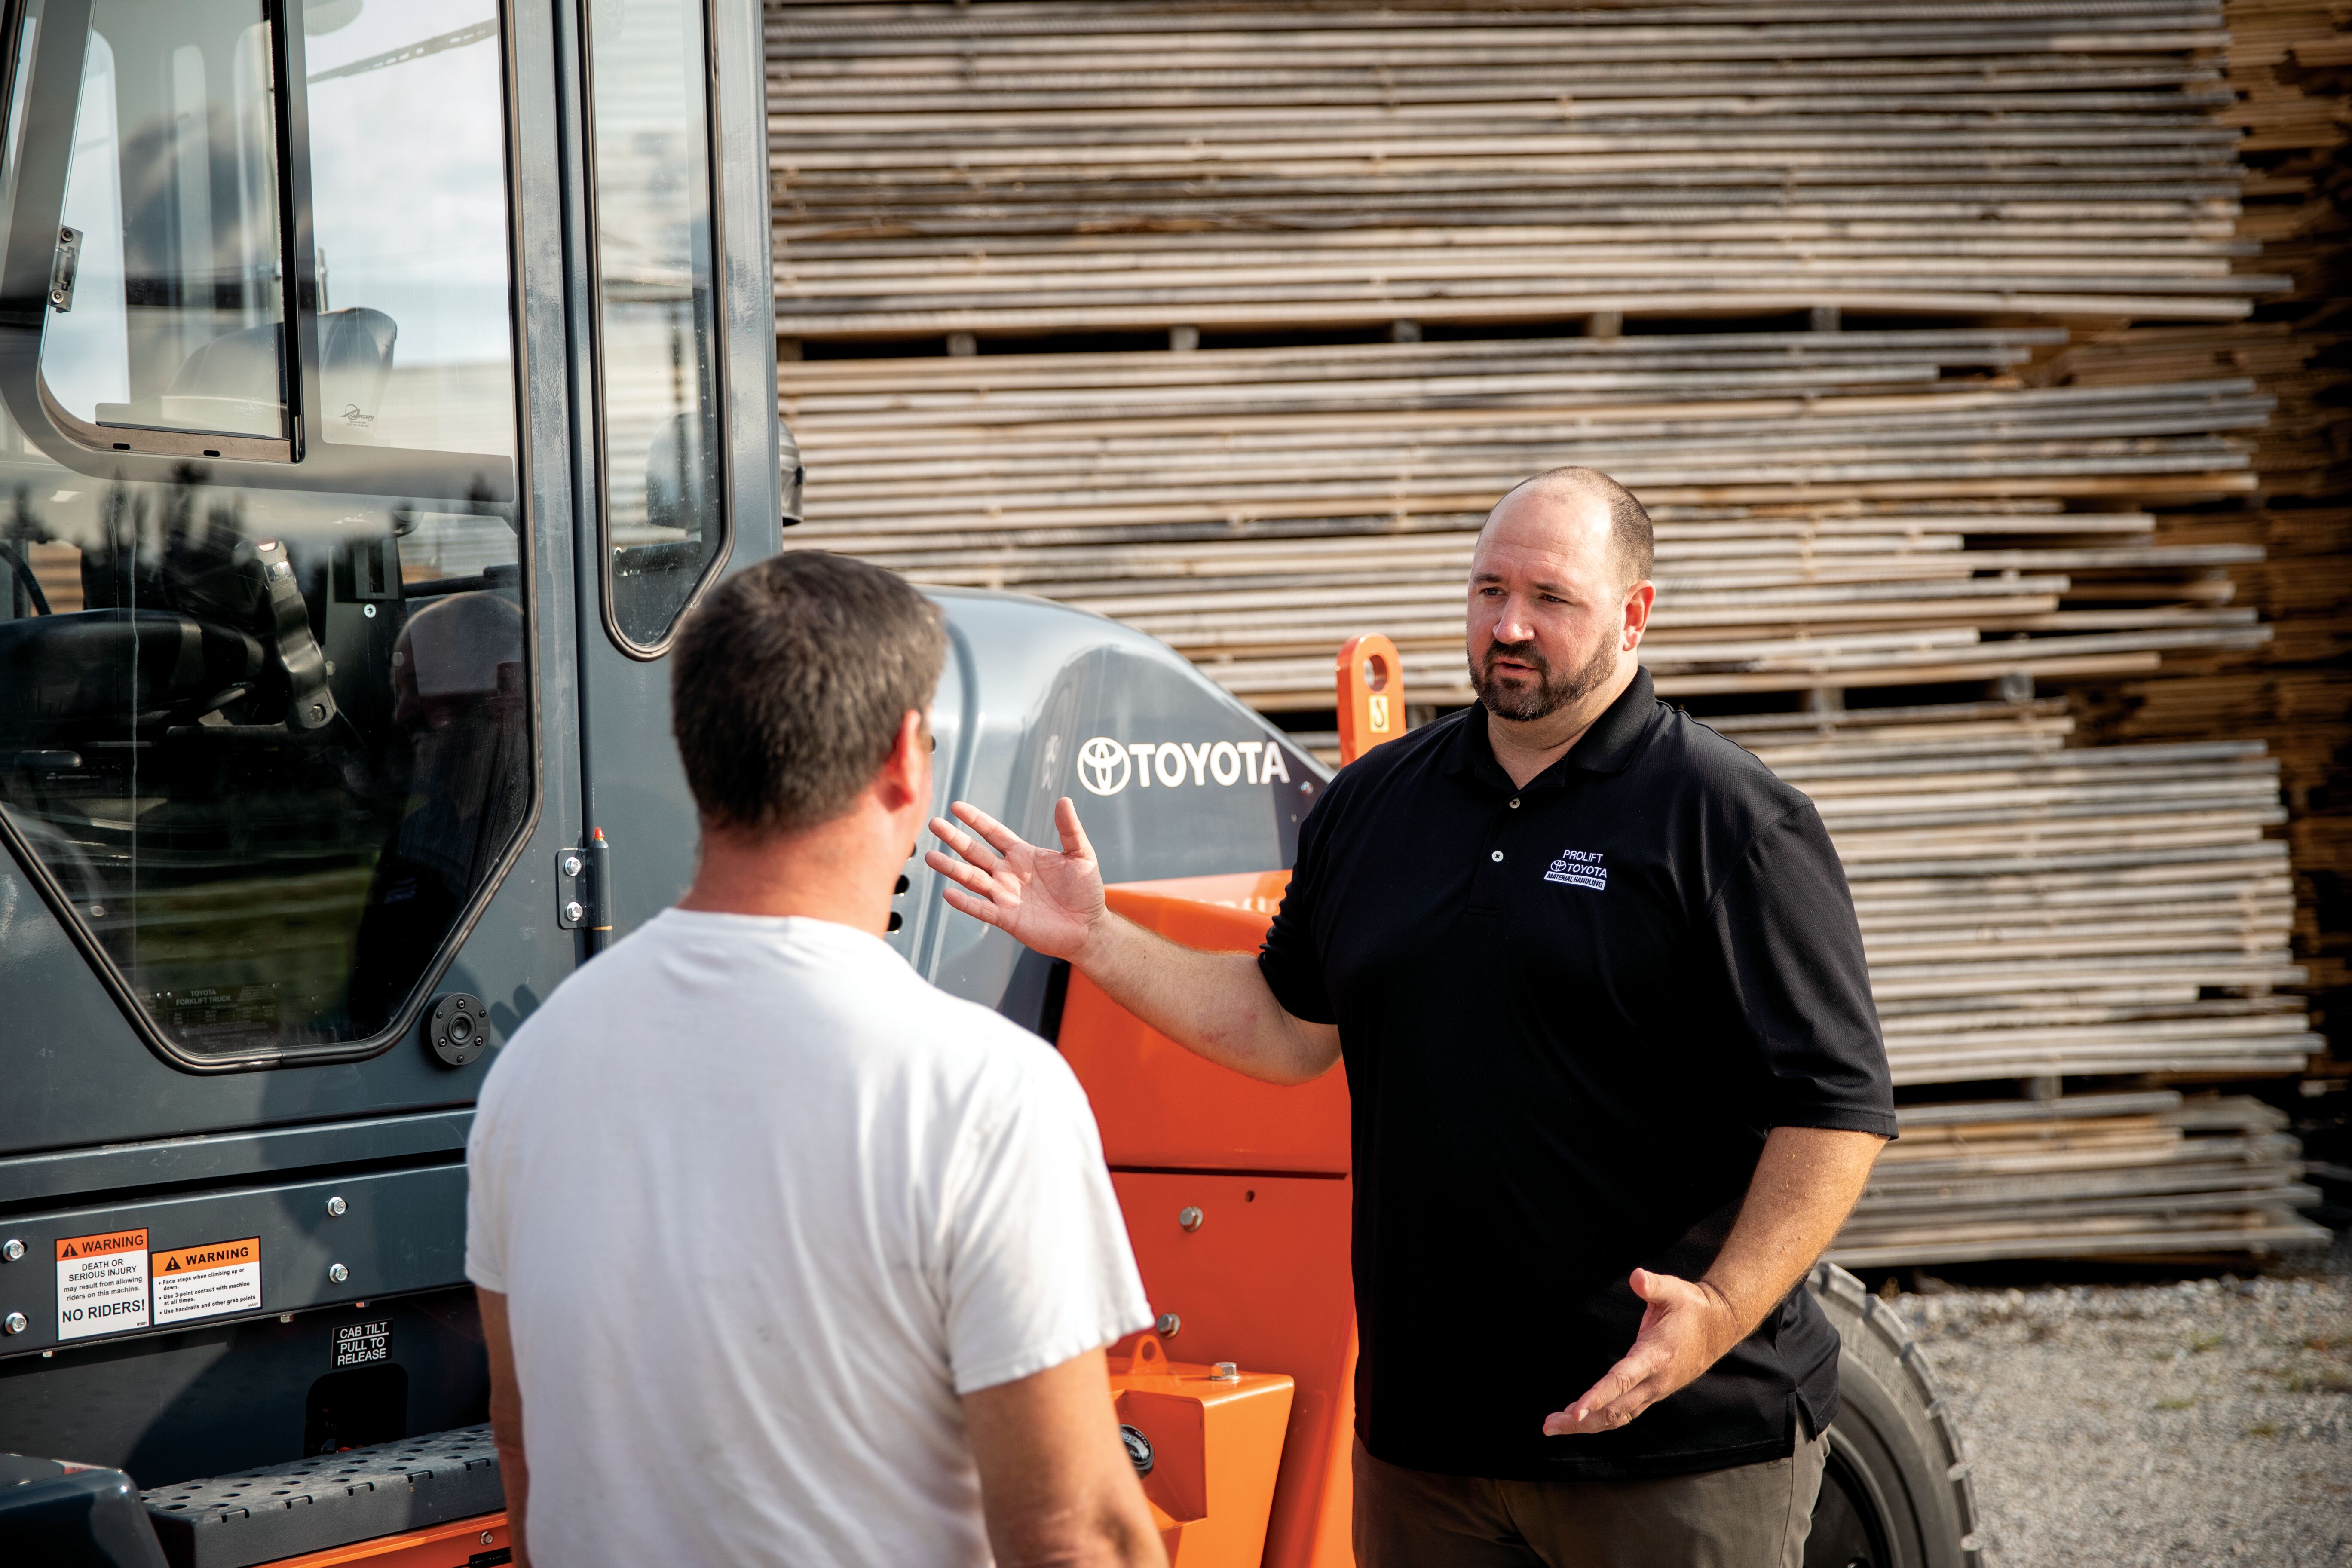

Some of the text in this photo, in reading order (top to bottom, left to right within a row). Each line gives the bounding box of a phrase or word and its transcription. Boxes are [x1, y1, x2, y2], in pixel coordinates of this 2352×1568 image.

[1128, 741, 1290, 788] TOYOTA
[1562, 849, 1603, 863] PROLIFT
[1567, 863, 1607, 878] TOYOTA
[1547, 873, 1603, 888] MATERIAL HANDLING
[176, 995, 231, 1006] FORKLIFT TRUCK
[190, 989, 216, 997] TOYOTA
[82, 1234, 144, 1253] WARNING
[186, 1247, 249, 1265] WARNING
[69, 1266, 137, 1281] SERIOUS INJURY
[82, 1261, 109, 1271] DEATH
[99, 1279, 114, 1287] from
[116, 1277, 142, 1285] allowing
[111, 1286, 140, 1295] machine.
[63, 1299, 144, 1323] NO RIDERS!
[340, 1322, 387, 1339] CAB TILT
[340, 1337, 385, 1354] PULL TO
[337, 1348, 386, 1366] RELEASE
